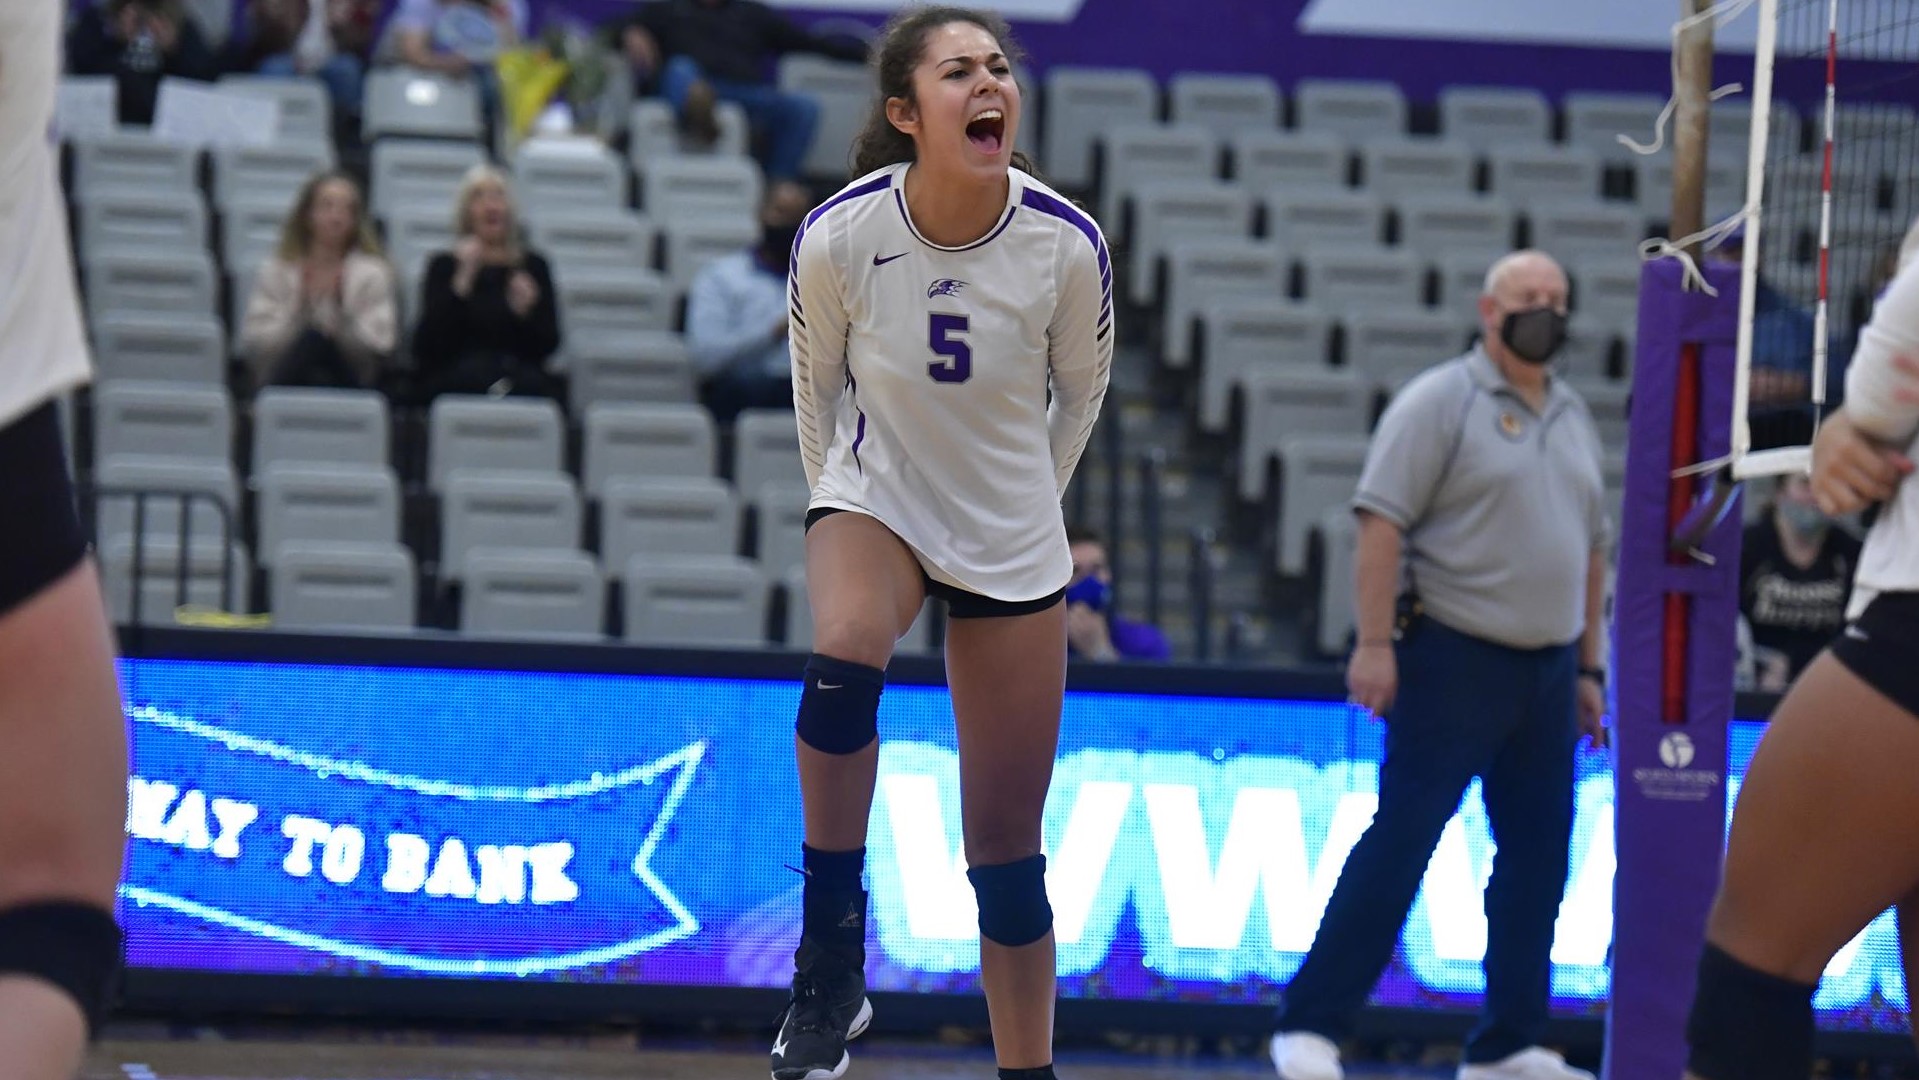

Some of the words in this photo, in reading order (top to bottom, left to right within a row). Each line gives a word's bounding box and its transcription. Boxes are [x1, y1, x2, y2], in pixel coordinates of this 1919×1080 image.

[927, 311, 973, 385] 5
[282, 814, 365, 884] TO
[382, 833, 578, 904] BANK
